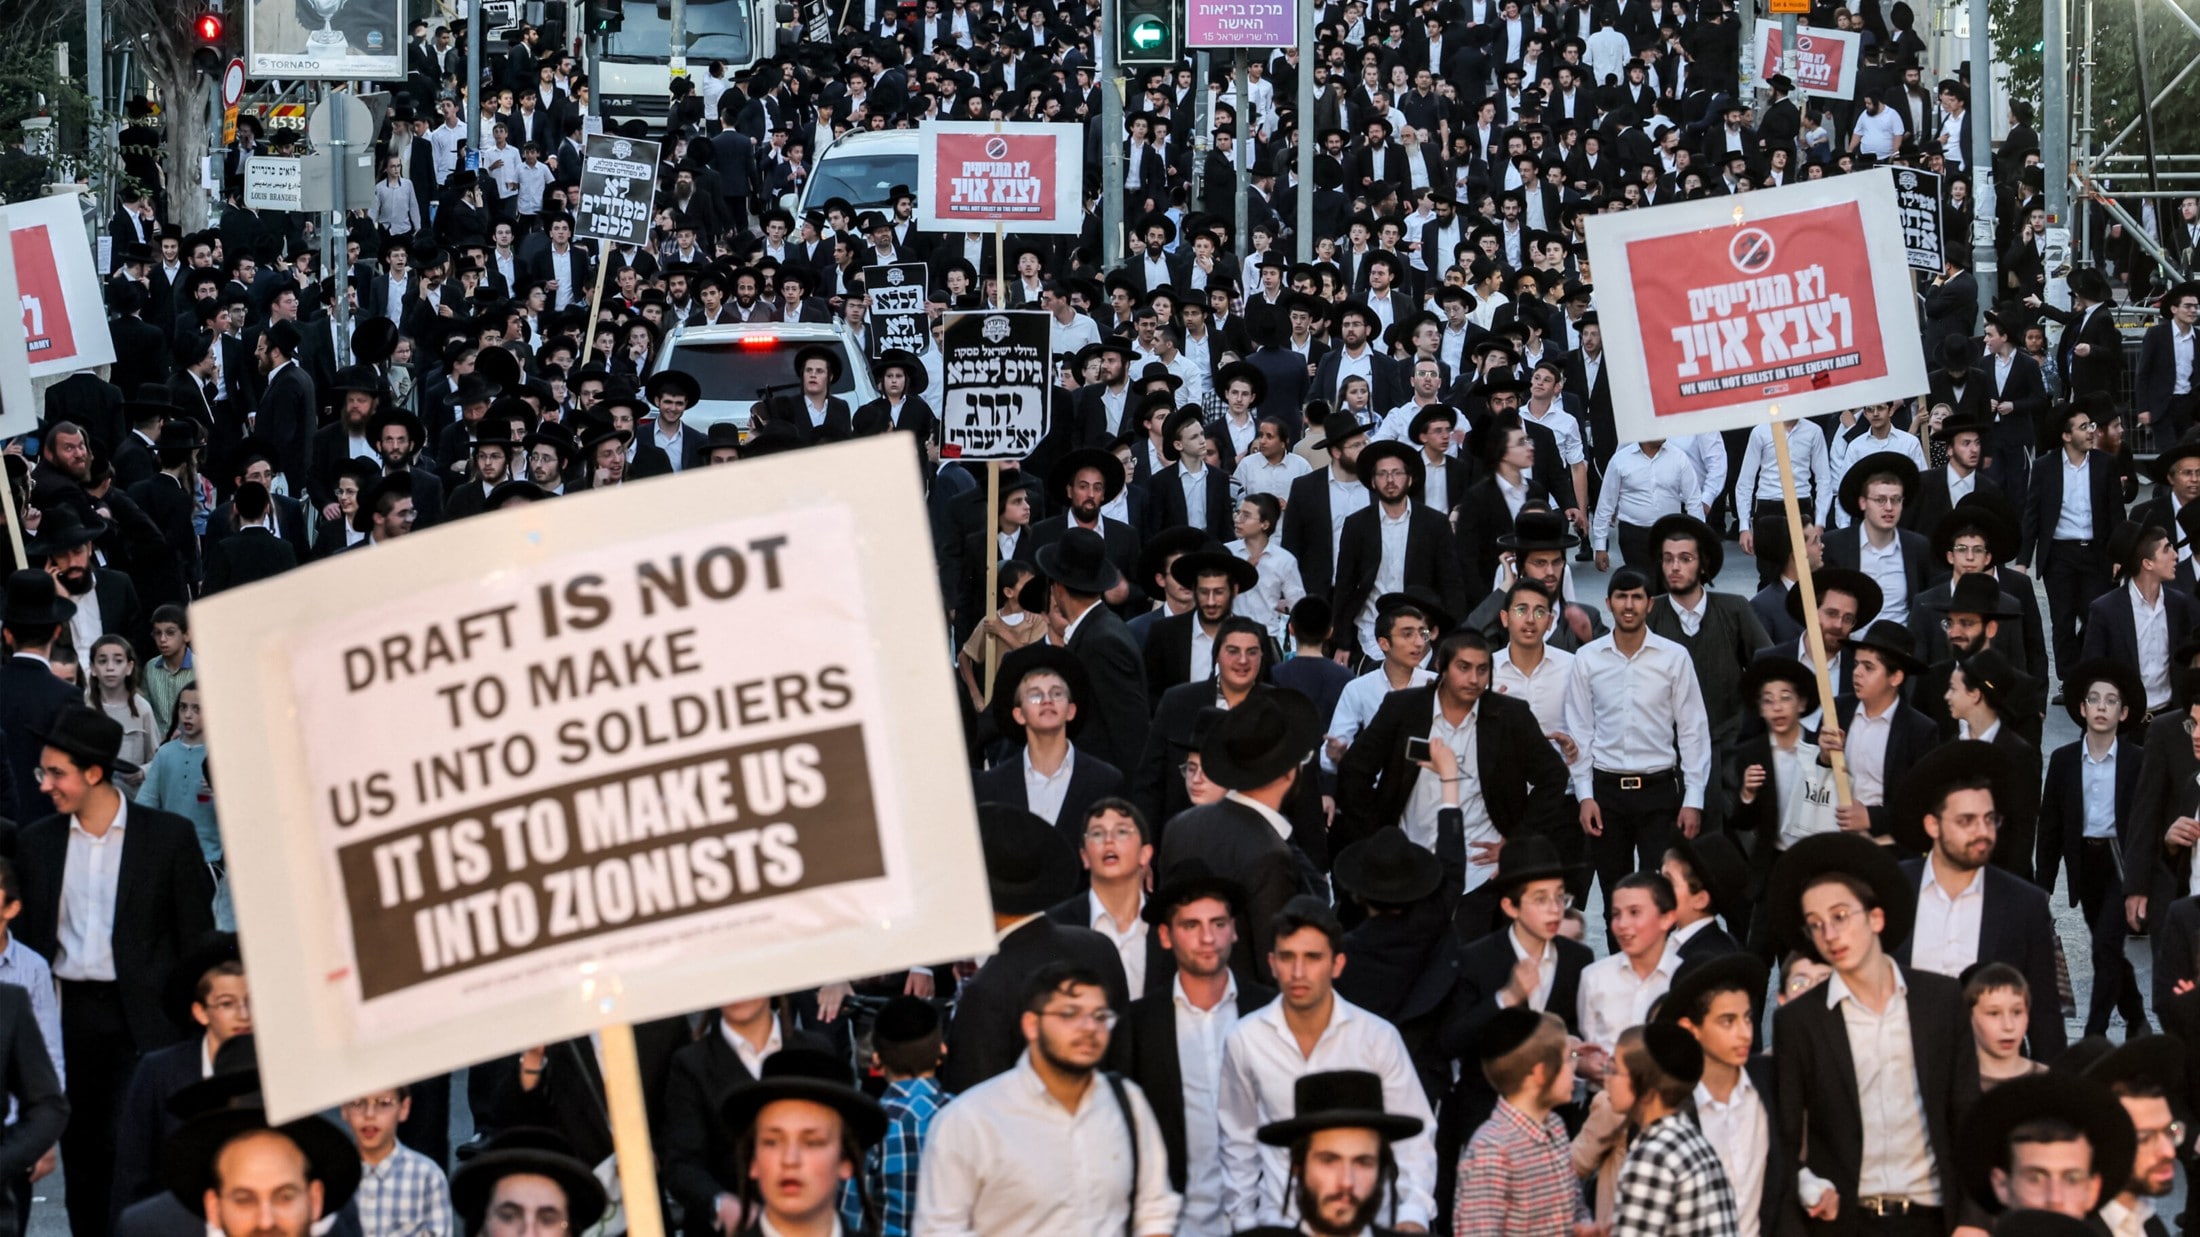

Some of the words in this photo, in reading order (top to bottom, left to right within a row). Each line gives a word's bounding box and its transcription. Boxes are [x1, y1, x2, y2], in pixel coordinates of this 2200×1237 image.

[1199, 4, 1246, 15] בריאות
[1250, 4, 1283, 15] מרכז
[1218, 18, 1264, 29] האישה
[1202, 32, 1214, 41] 15
[1216, 31, 1244, 41] ישראל
[1246, 32, 1262, 41] שרי
[1264, 32, 1279, 41] רח'
[271, 60, 320, 69] TORNADO
[269, 116, 306, 130] 4539
[962, 161, 1012, 177] מתגייסים
[1014, 160, 1030, 177] לא
[251, 192, 268, 200] LOUIS
[269, 192, 298, 201] BRANDEIS
[603, 178, 630, 198] לא
[951, 178, 989, 203] אויב
[991, 176, 1041, 203] לצבא
[581, 193, 647, 220] מפחדים
[1901, 190, 1936, 212] אפילו
[590, 213, 633, 238] מכם!
[1794, 263, 1826, 303] לא
[875, 288, 918, 310] לכלא
[1687, 273, 1794, 322] מתגייסים
[886, 314, 916, 335] ולא
[1756, 293, 1853, 363] לצבא
[29, 338, 51, 350] ARMY
[880, 333, 923, 354] לצבא
[981, 344, 1011, 357] ישראל
[1014, 344, 1038, 357] גדולי
[1671, 316, 1753, 378] אויב
[947, 356, 1001, 385] לצבא
[1004, 359, 1044, 384] גיוס
[1680, 383, 1697, 396] WE
[1697, 379, 1721, 393] WILL
[1721, 375, 1740, 389] NOT
[1742, 370, 1775, 386] ENLIST
[1775, 367, 1788, 380] IN
[1788, 364, 1805, 378] THE
[1806, 358, 1835, 374] ENEMY
[1835, 353, 1860, 369] ARMY
[965, 392, 1023, 426] יהרג
[1006, 425, 1037, 449] ואל
[341, 602, 518, 694] DRAFT
[535, 573, 612, 639] IS
[635, 534, 789, 617] NOT
[437, 674, 509, 729] TO
[526, 627, 702, 708] MAKE
[329, 771, 396, 828] US
[413, 732, 537, 803] INTO
[557, 664, 854, 765] SOLDIERS
[371, 833, 424, 908] IT
[428, 817, 493, 892] IS
[491, 798, 570, 872] TO
[573, 759, 738, 852] MAKE
[739, 743, 827, 816] US
[413, 882, 539, 973] INTO
[542, 822, 804, 938] ZIONISTS
